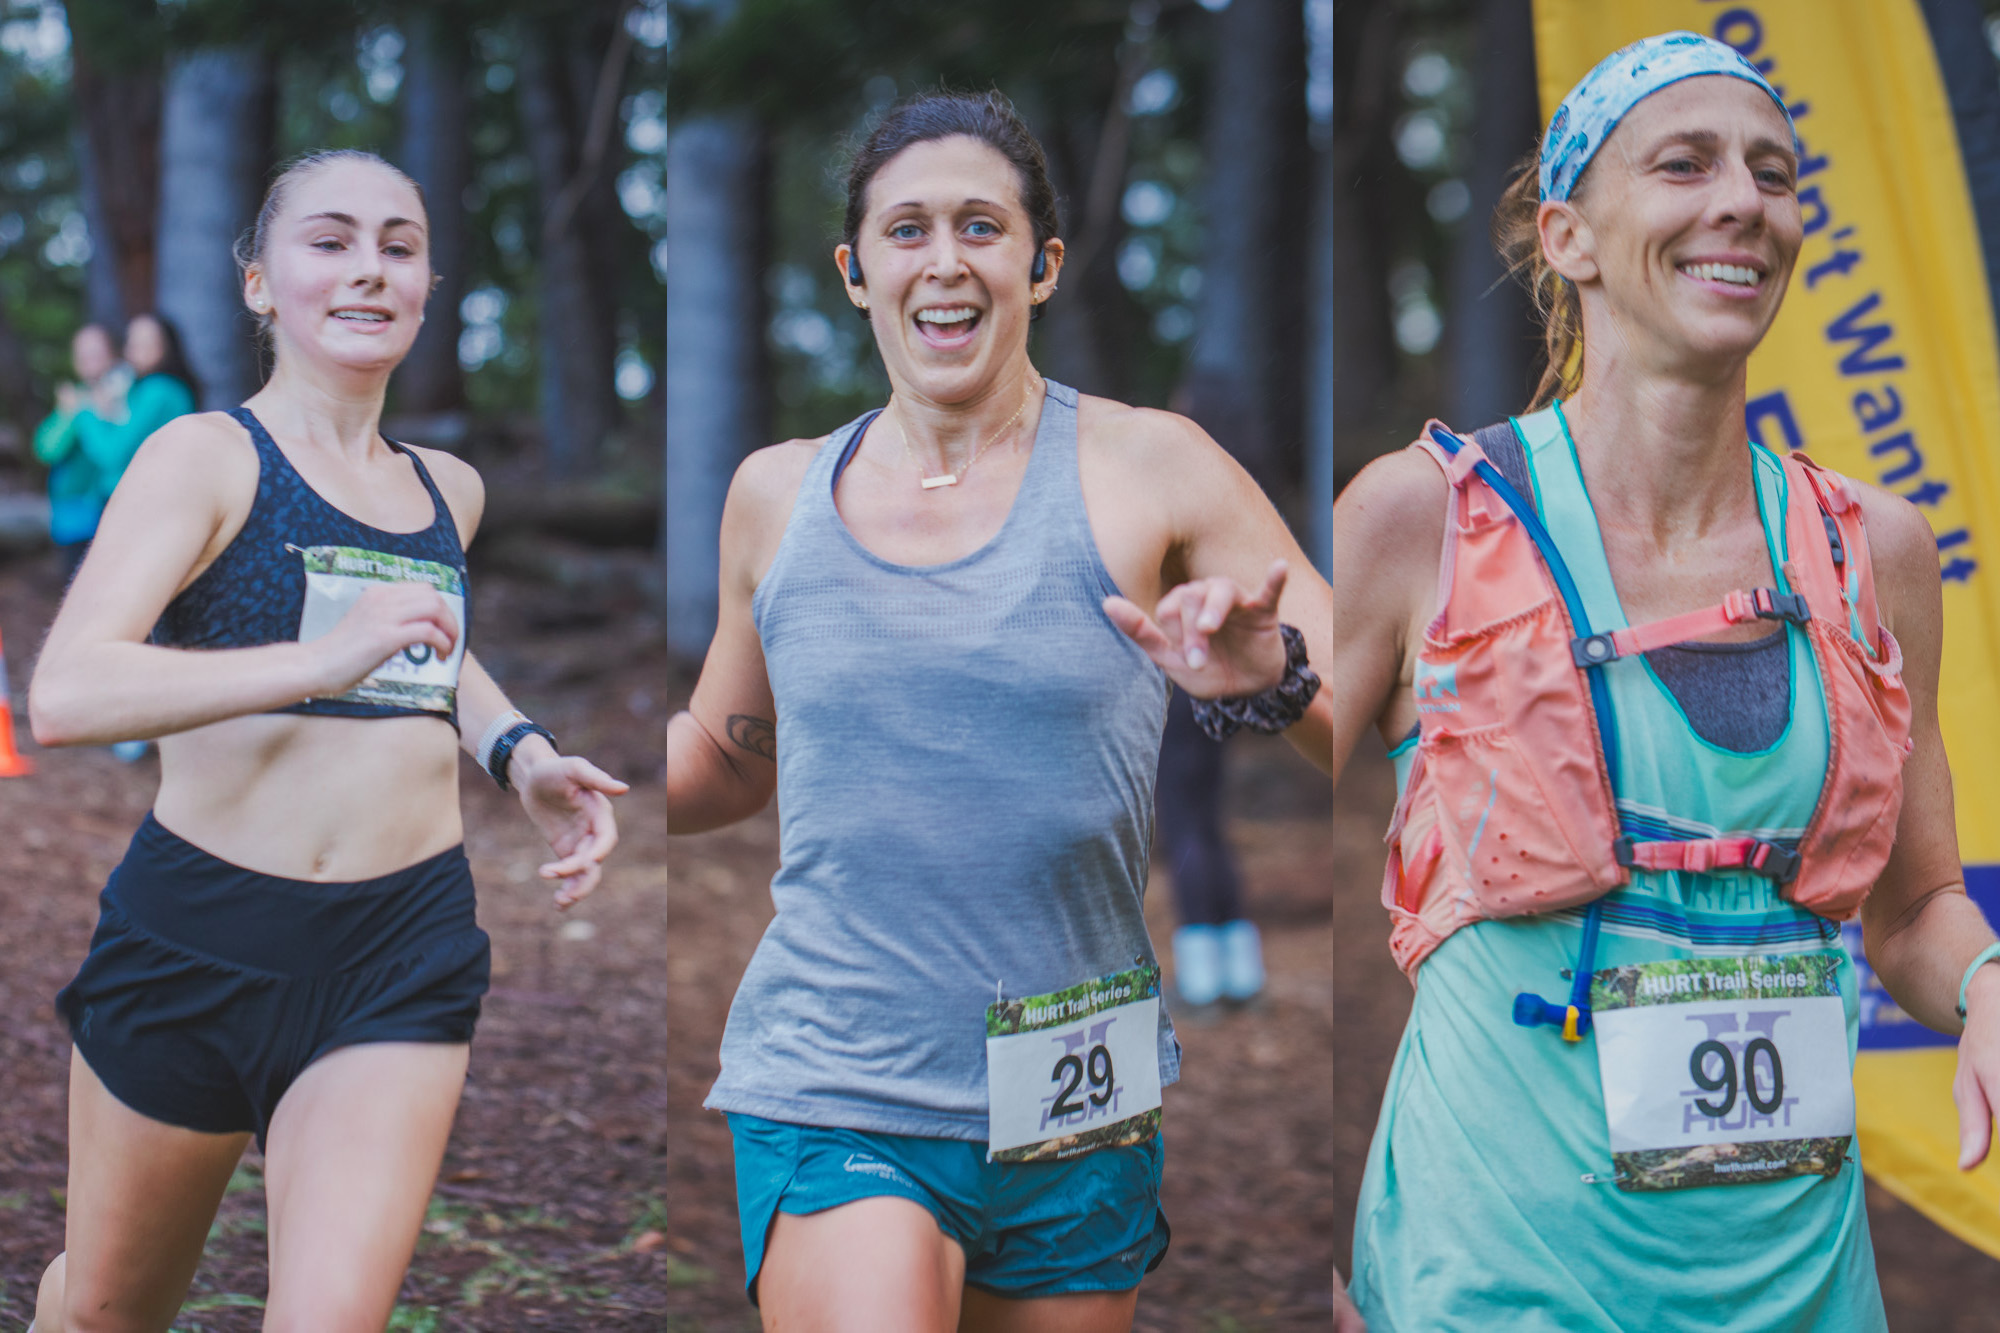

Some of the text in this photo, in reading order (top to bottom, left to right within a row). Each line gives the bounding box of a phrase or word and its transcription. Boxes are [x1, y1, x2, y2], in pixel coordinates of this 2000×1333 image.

[1825, 291, 1948, 505] Want
[1025, 984, 1131, 1025] HURT Trail Series
[1643, 969, 1807, 995] HURT Trail Series
[1049, 1044, 1114, 1118] 29
[1690, 1037, 1784, 1118] 90
